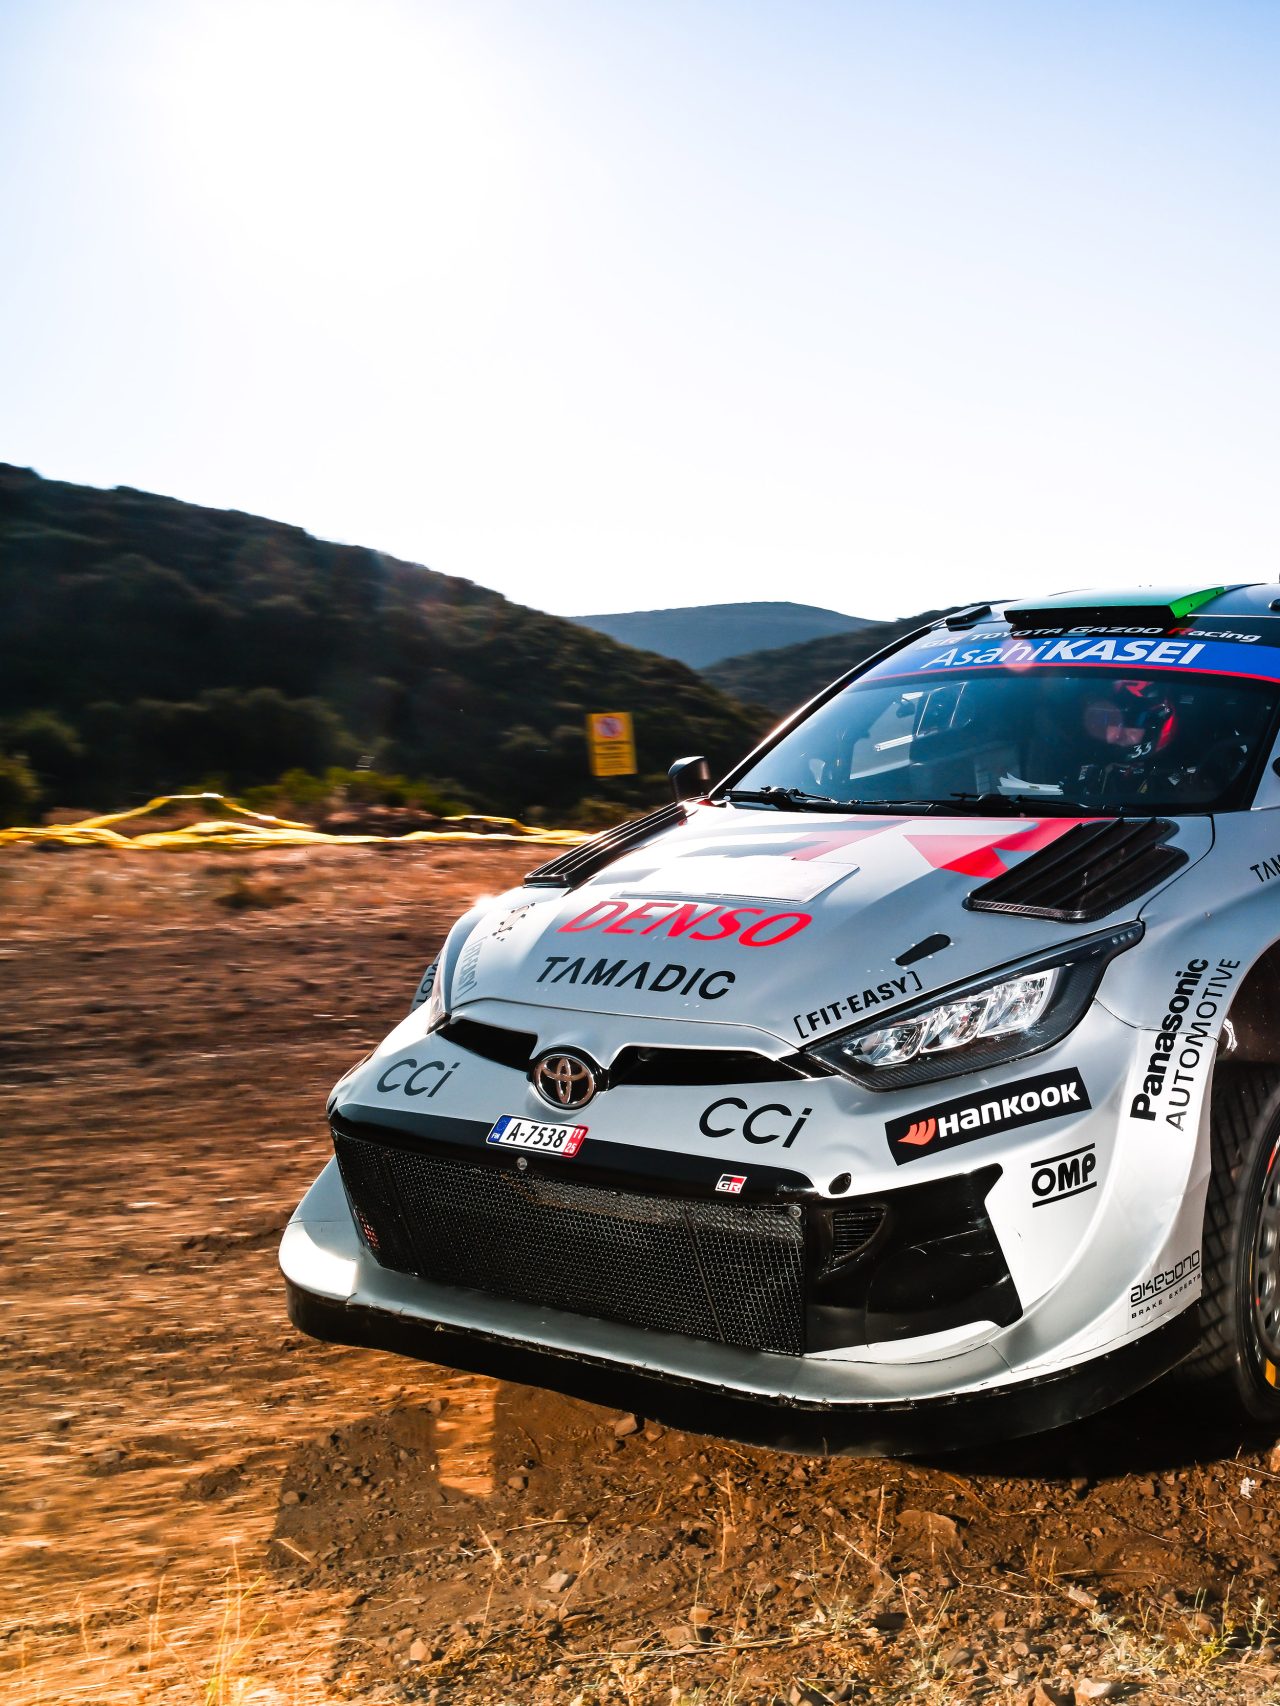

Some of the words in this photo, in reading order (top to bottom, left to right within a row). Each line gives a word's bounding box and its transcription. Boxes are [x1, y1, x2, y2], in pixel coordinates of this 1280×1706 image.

[919, 639, 1206, 669] AsahiKASEI
[970, 627, 1064, 641] TOYOTA
[1064, 625, 1163, 635] GAZOO
[1167, 627, 1262, 643] Racing
[556, 901, 813, 948] DENSO
[536, 956, 736, 1000] TAMADIC
[1130, 958, 1209, 1121] Panasonic
[1165, 958, 1241, 1131] AUTOMOTIVE
[377, 1059, 460, 1097] CCi
[506, 1122, 568, 1148] A-7538
[699, 1097, 812, 1148] CCi
[565, 1142, 577, 1153] 25
[718, 1180, 741, 1192] GR
[1031, 1153, 1098, 1199] OMP
[1131, 1299, 1163, 1319] BRAKE
[1168, 1273, 1201, 1300] EXPERTS
